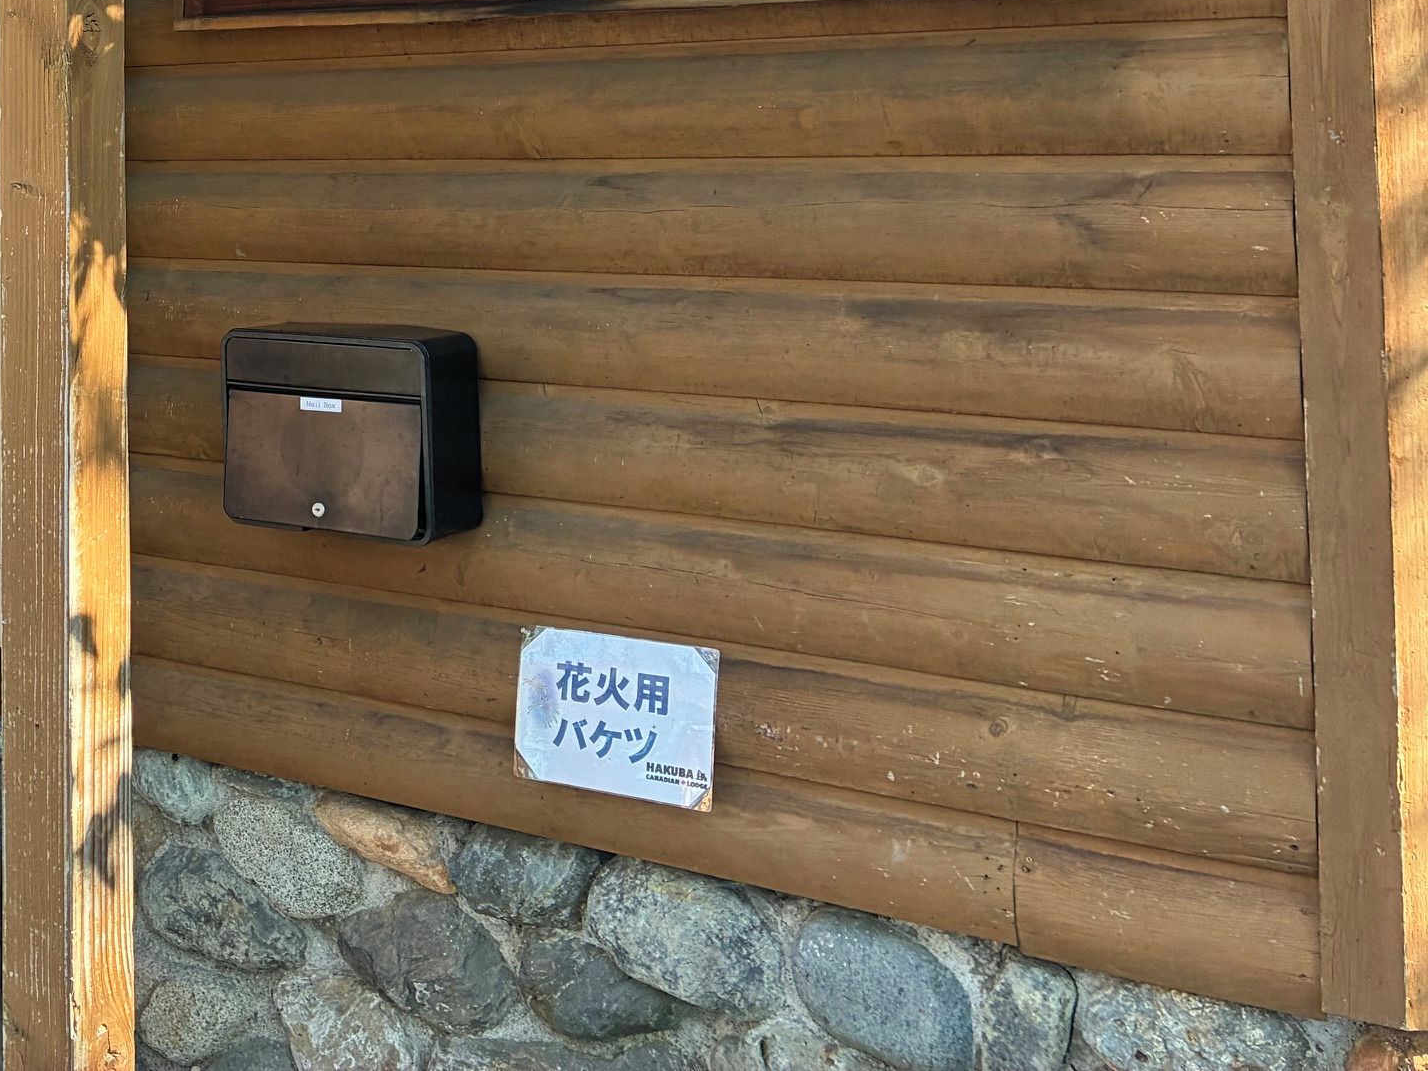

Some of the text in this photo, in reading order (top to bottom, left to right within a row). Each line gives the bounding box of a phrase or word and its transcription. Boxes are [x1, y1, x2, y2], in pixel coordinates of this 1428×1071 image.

[306, 400, 321, 408] Mail
[555, 660, 671, 716] 花火用
[552, 717, 658, 764] バケツ
[645, 761, 694, 779] HAKUBA
[645, 774, 708, 790] CANADIAN LODGE
